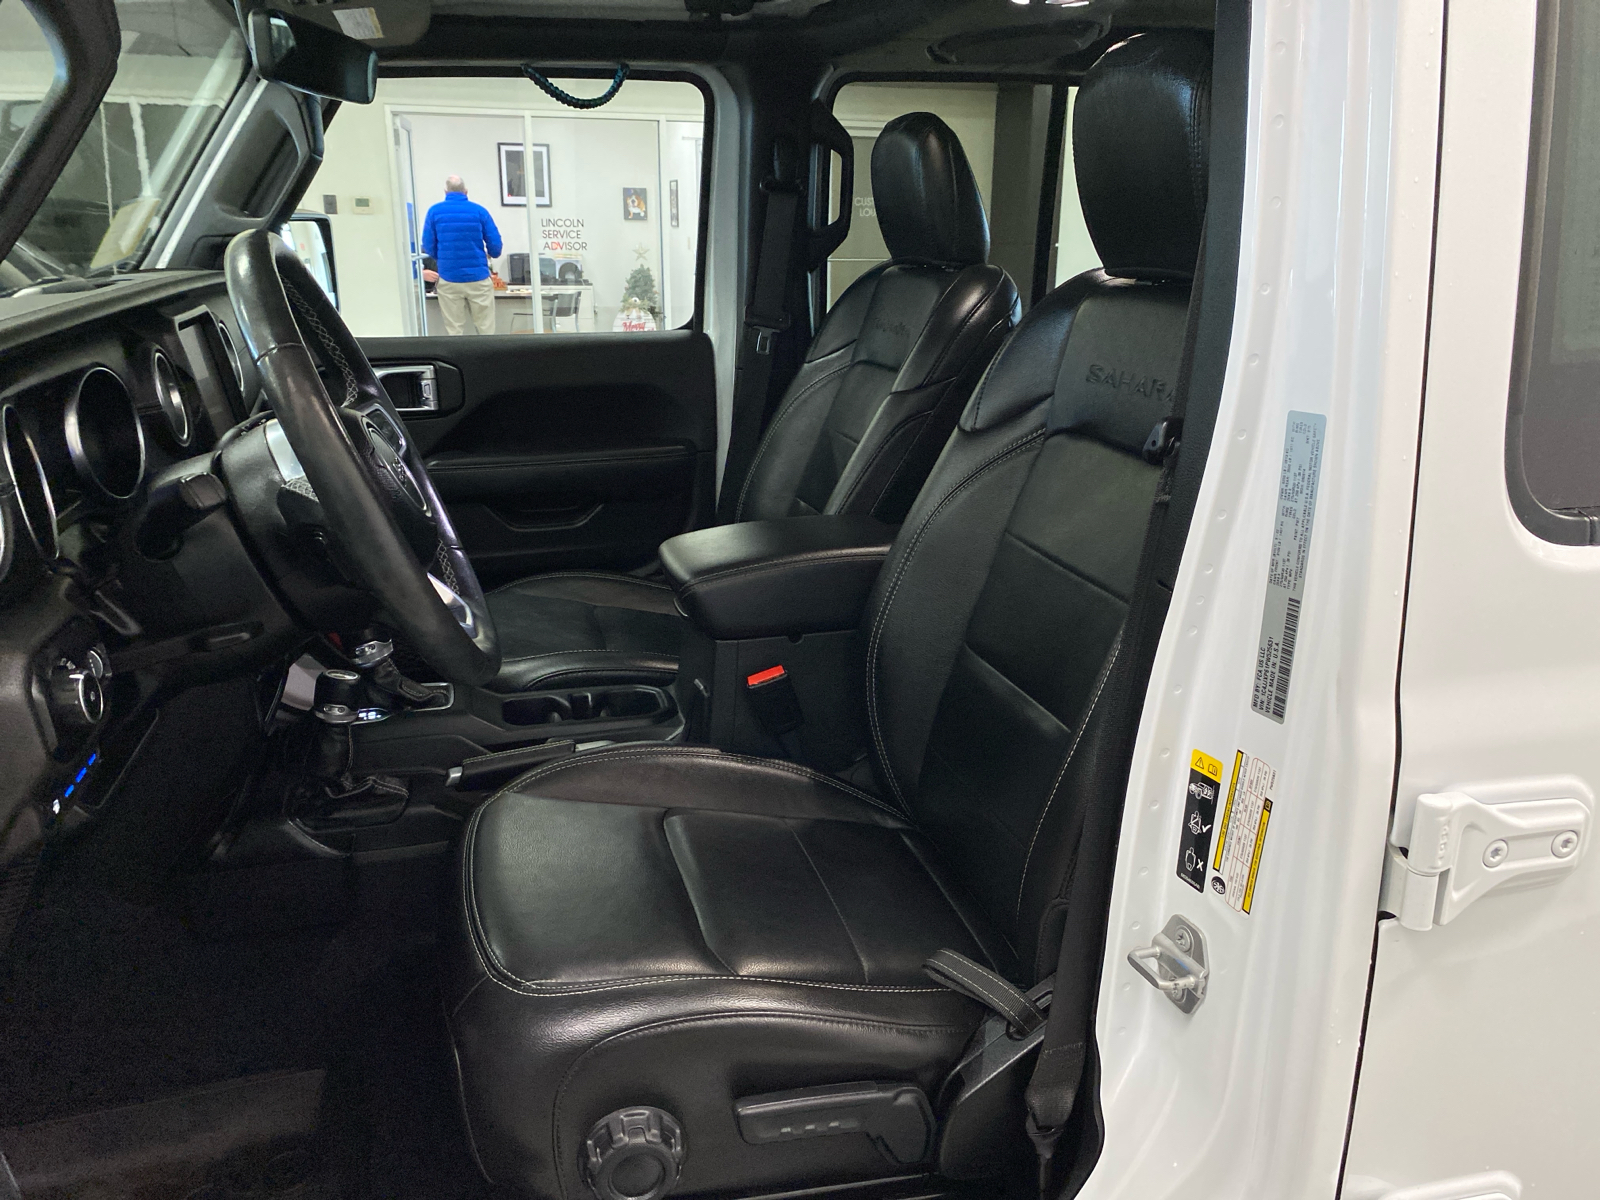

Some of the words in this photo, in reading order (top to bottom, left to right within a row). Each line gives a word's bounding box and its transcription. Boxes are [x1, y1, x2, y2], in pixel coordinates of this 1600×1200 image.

[541, 218, 584, 228] LINCOLN
[542, 230, 581, 239] SERVICE
[543, 242, 588, 250] ADVISOR
[1258, 658, 1263, 667] US
